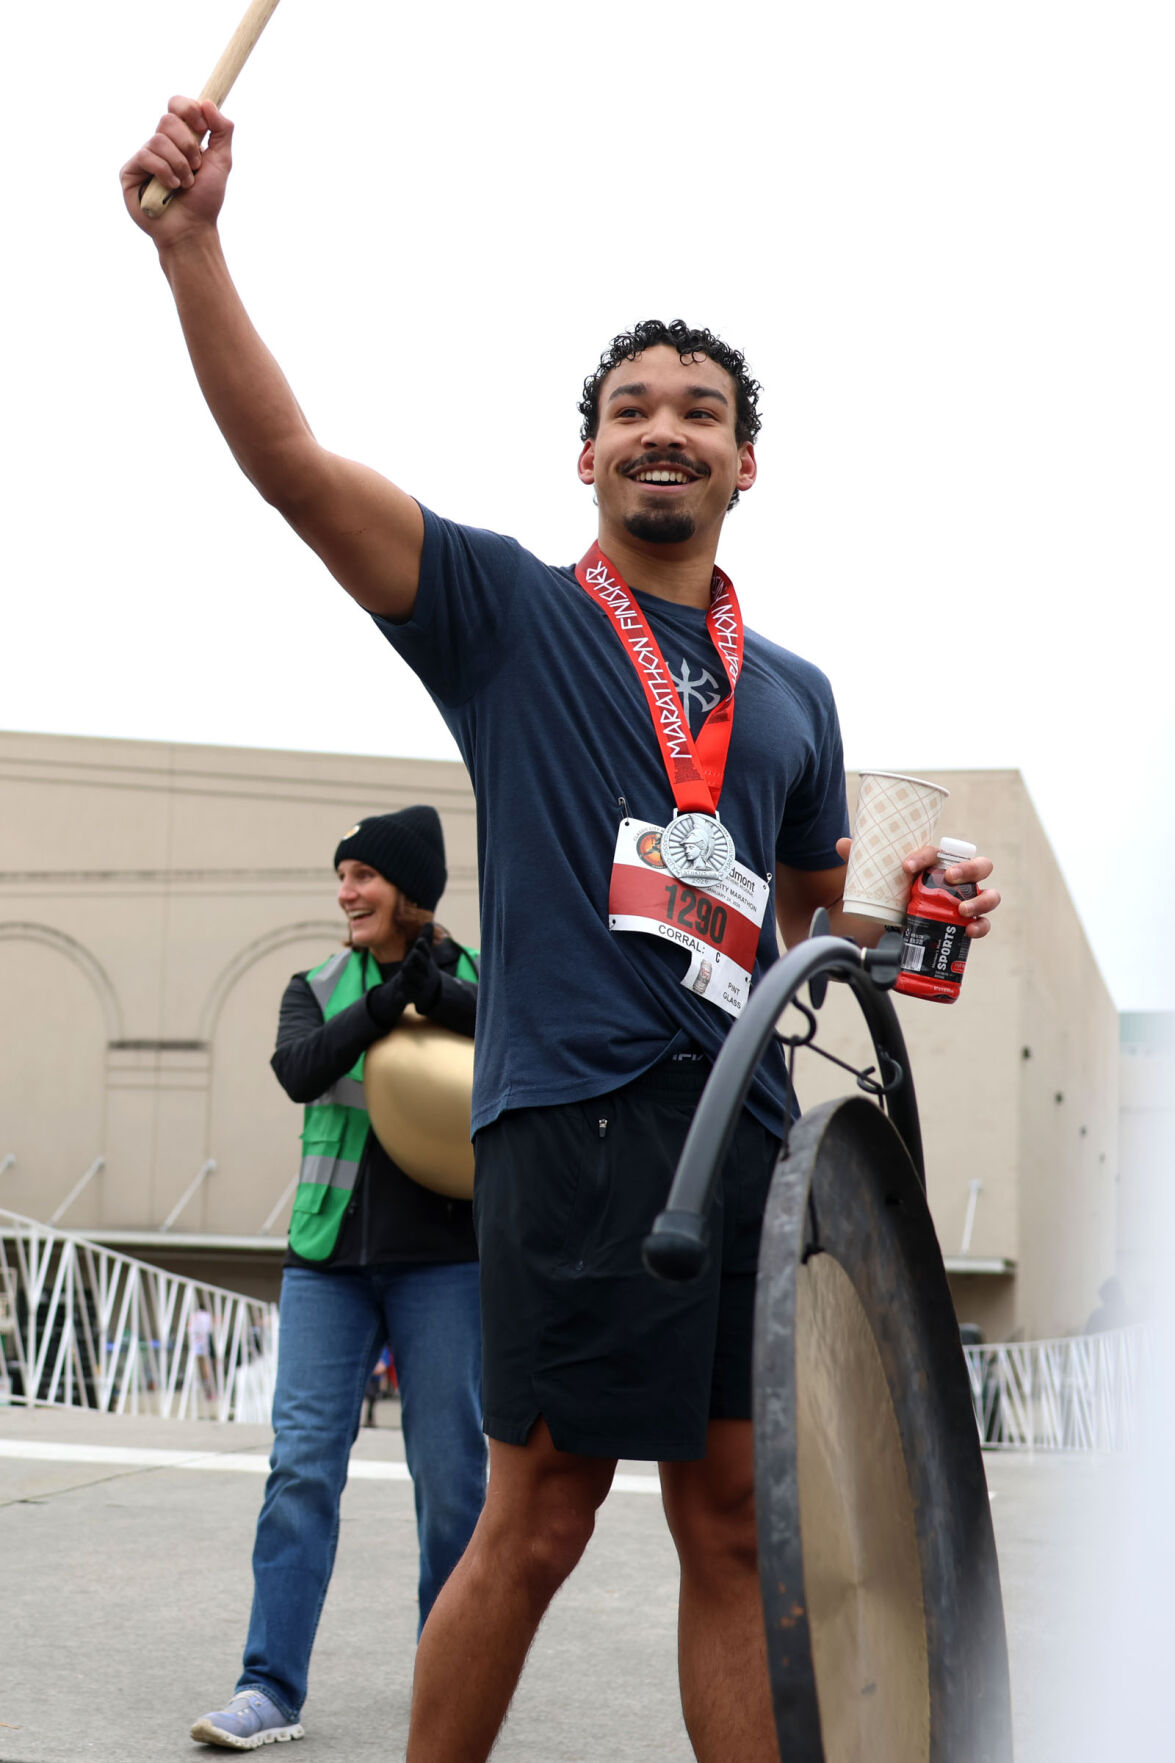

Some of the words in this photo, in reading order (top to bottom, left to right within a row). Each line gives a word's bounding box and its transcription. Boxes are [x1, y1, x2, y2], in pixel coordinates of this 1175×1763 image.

[586, 560, 643, 630] FINISHER
[711, 604, 739, 702] RATHON
[628, 637, 692, 758] MARATHON
[665, 883, 728, 944] 1290
[730, 888, 757, 912] MARATHON
[658, 924, 706, 954] CORRAL:
[715, 952, 721, 964] C
[937, 925, 957, 971] SPORTS
[722, 991, 741, 1009] GLASS
[728, 982, 740, 996] PINT
